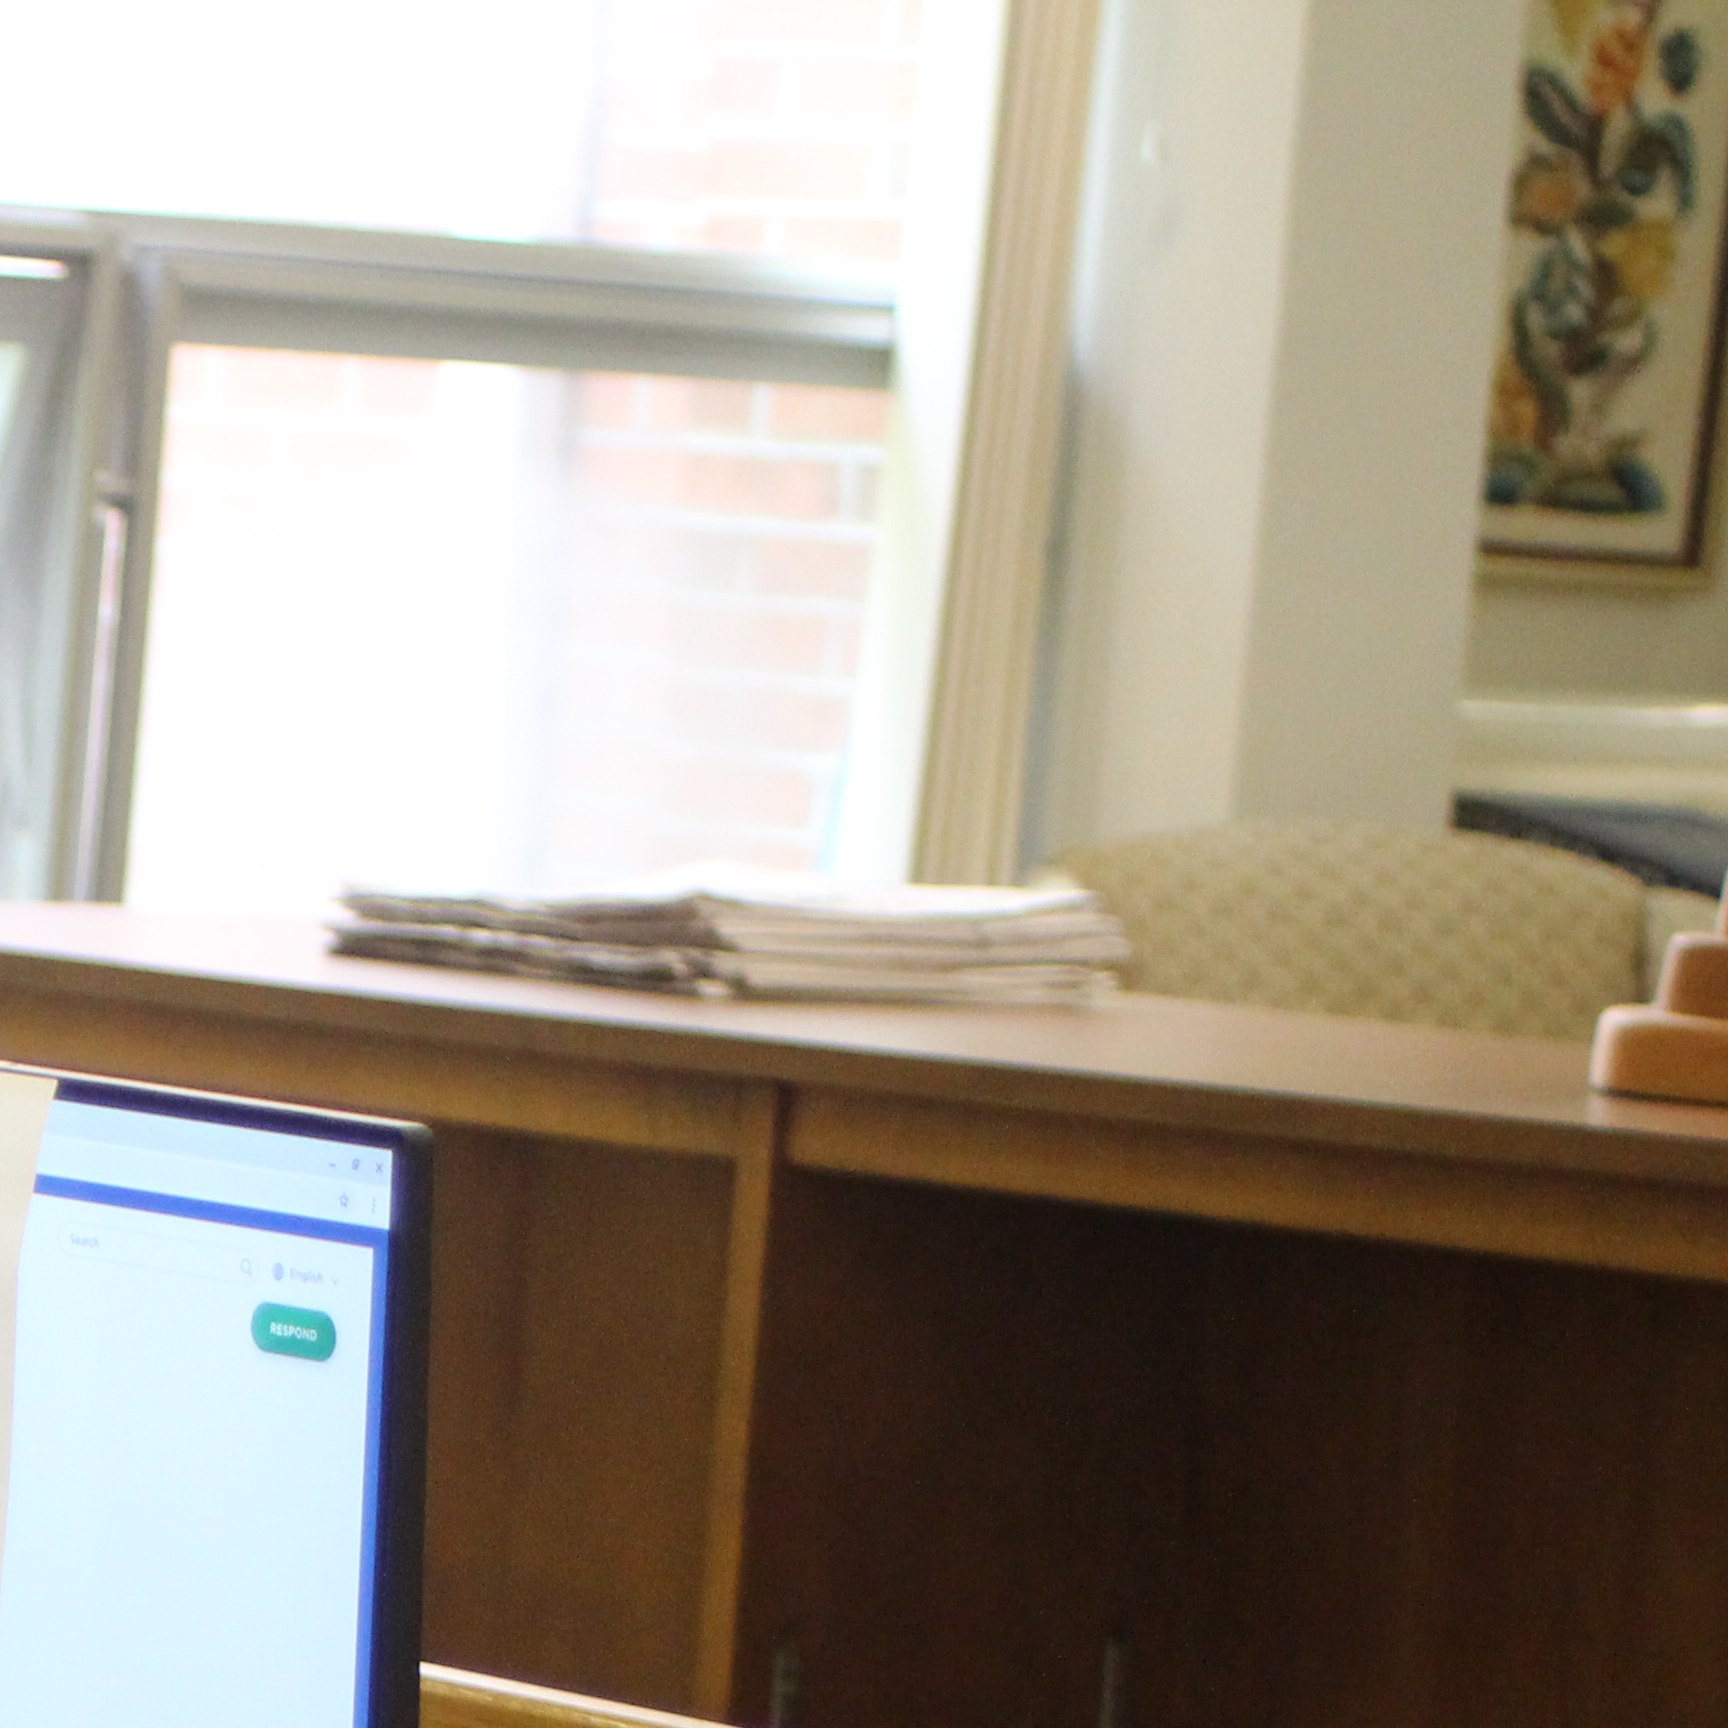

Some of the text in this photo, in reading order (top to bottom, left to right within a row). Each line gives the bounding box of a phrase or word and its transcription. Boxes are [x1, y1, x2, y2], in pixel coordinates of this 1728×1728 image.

[69, 1233, 100, 1249] Search
[289, 1266, 324, 1285] English
[269, 1321, 318, 1342] RESPOND
